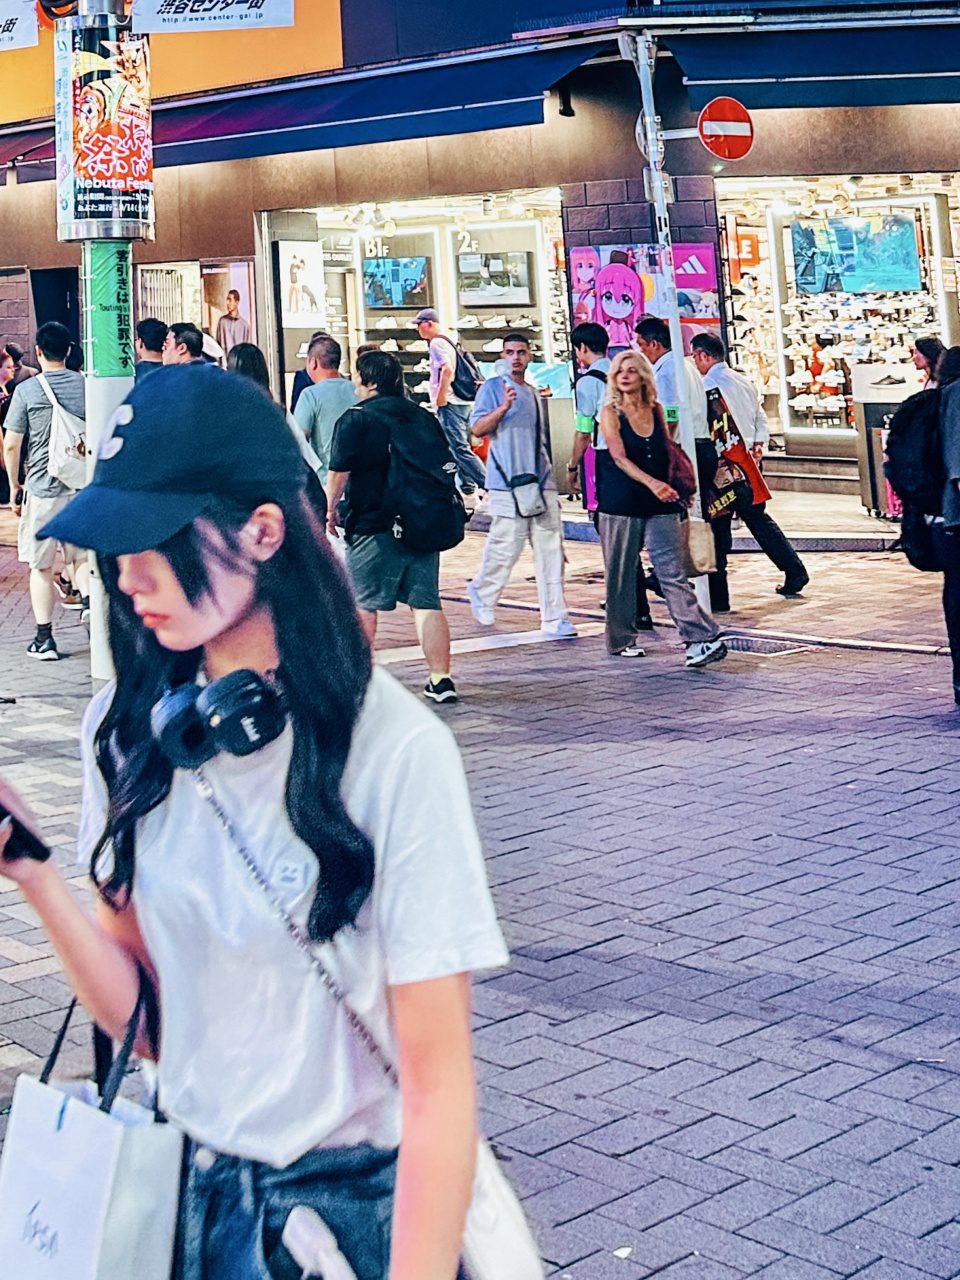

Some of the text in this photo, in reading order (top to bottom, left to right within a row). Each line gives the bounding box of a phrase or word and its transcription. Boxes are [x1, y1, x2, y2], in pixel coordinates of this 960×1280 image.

[76, 177, 125, 190] Nebuta
[364, 237, 390, 258] B1F
[457, 232, 479, 254] 2F
